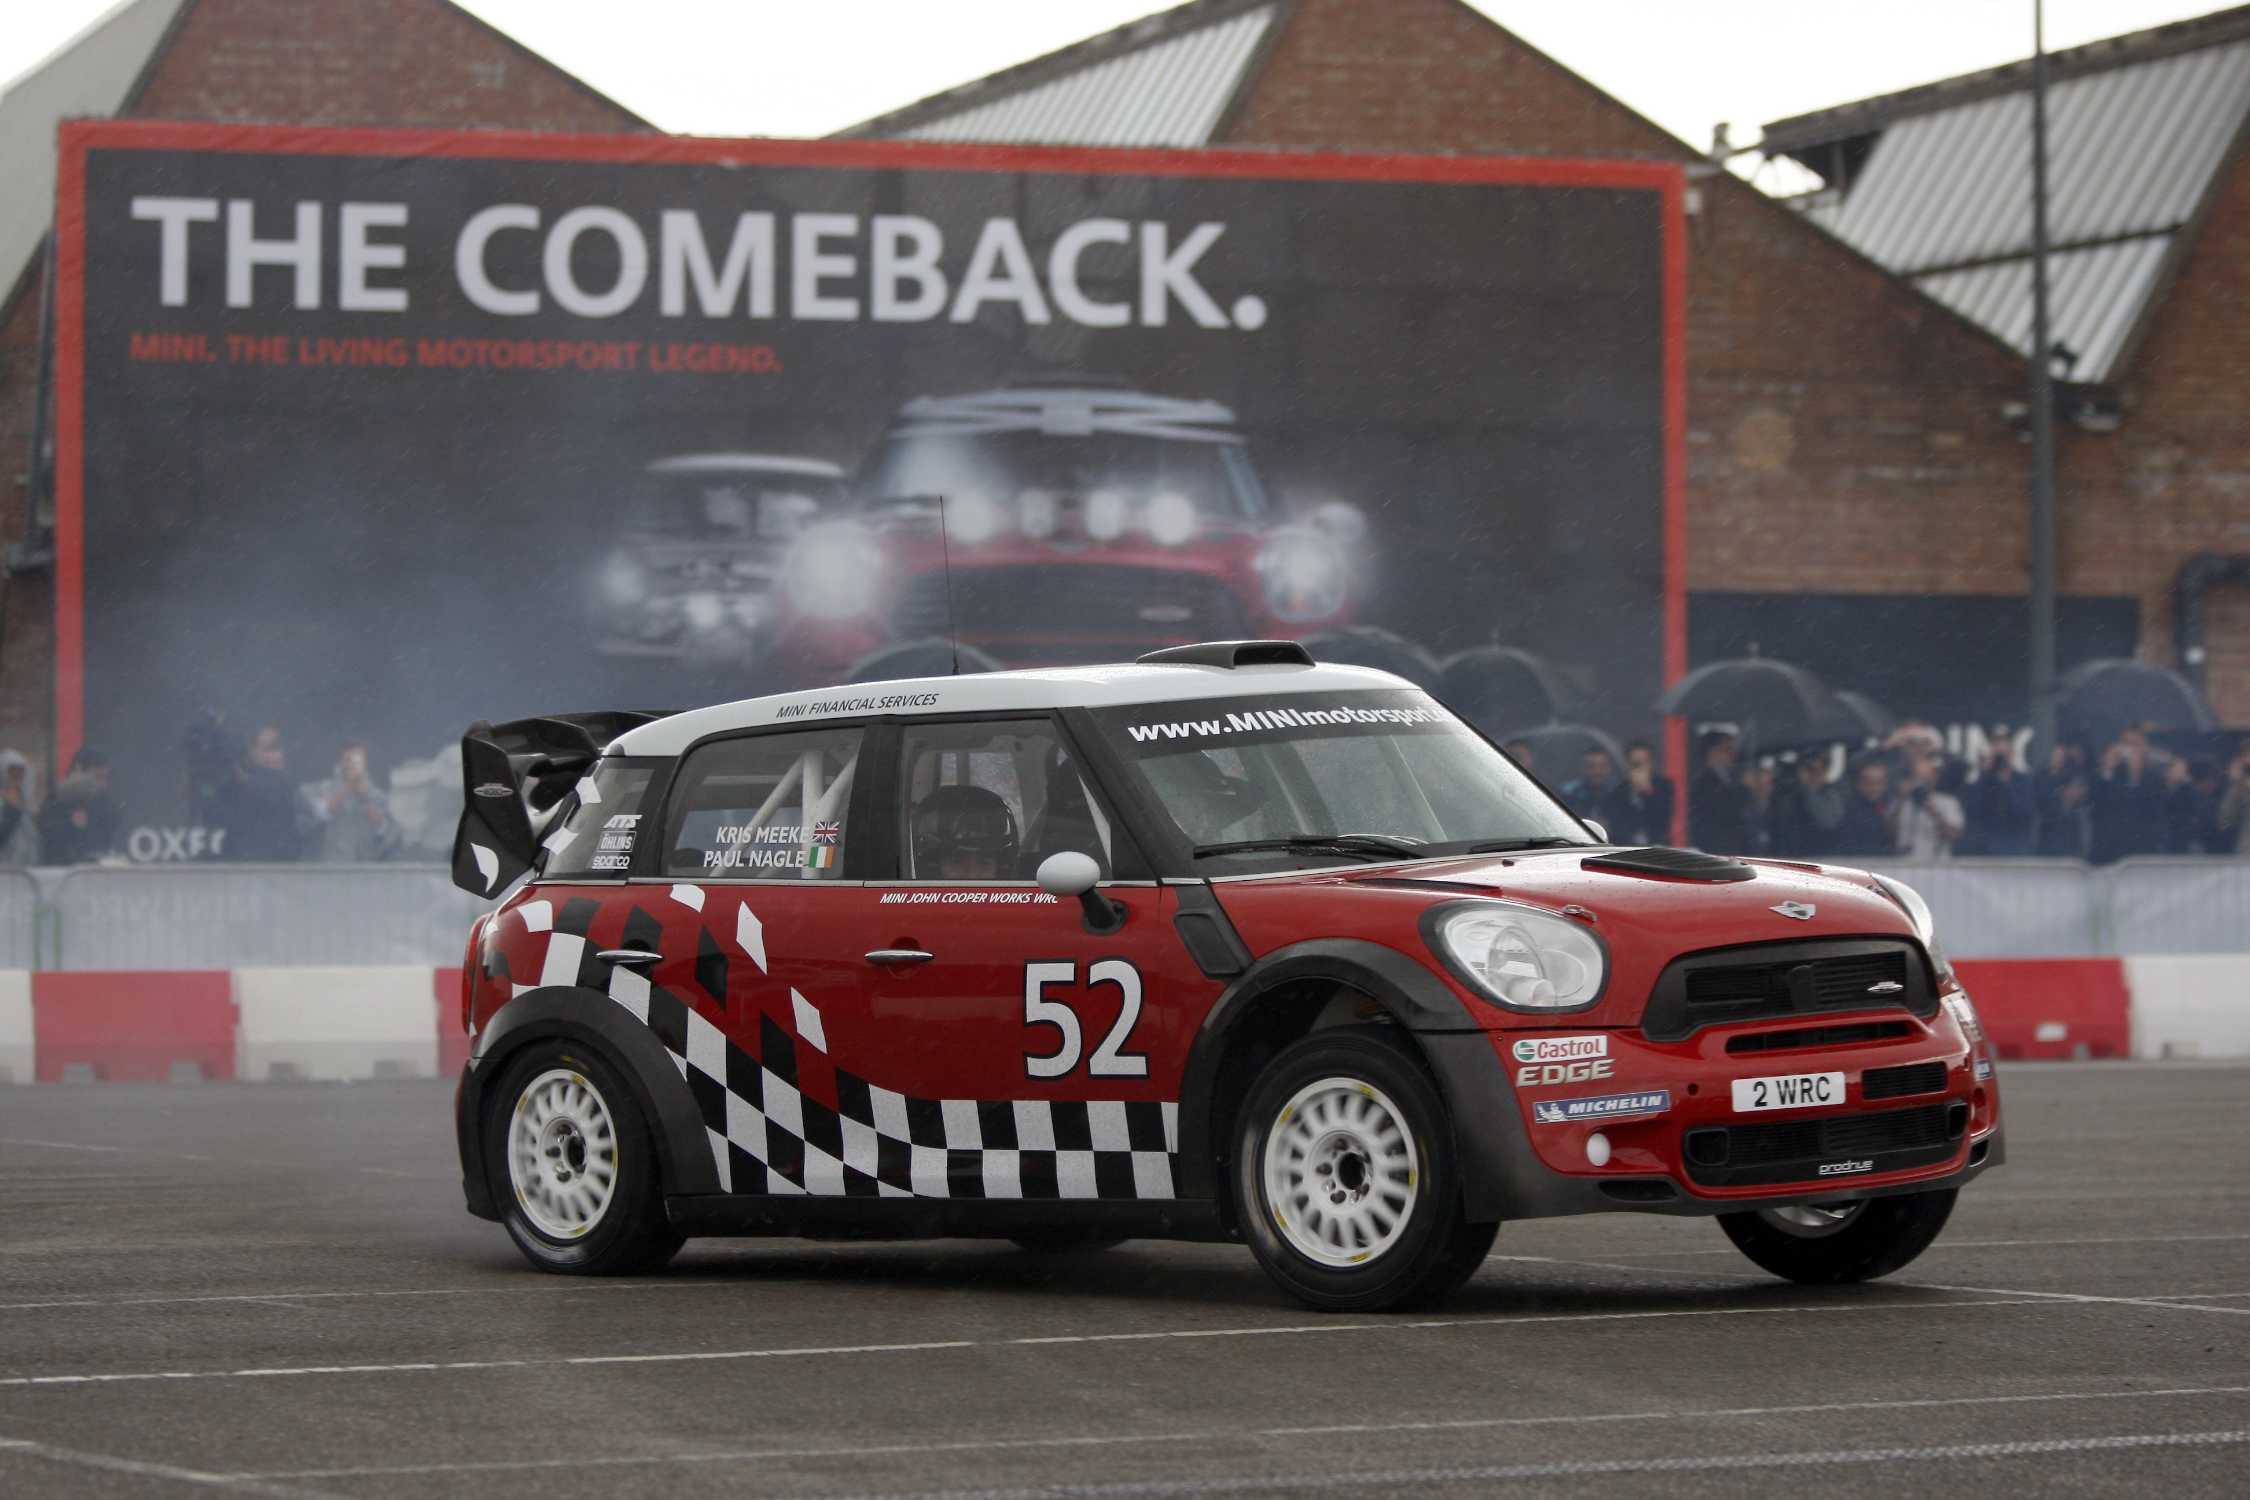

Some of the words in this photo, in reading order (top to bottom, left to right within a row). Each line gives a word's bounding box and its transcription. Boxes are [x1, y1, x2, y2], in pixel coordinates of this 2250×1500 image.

[131, 196, 409, 312] THE
[455, 204, 1268, 331] COMEBACK.
[130, 332, 217, 363] MINI.
[225, 334, 291, 366] THE
[300, 336, 409, 368] LIVING
[416, 337, 642, 371] MOTORSPORT
[651, 341, 784, 374] LEGEND.
[776, 704, 808, 718] MINI
[809, 698, 876, 714] FINANCIAL
[877, 693, 940, 709] SERVICES
[715, 826, 751, 844] KRIS
[755, 826, 810, 844] MEEKE
[703, 851, 745, 868] PAUL
[748, 851, 809, 868] NAGLE
[880, 892, 907, 904] MINI
[907, 892, 941, 904] JOHN
[941, 892, 988, 904] COOPER
[989, 892, 1034, 904] WORKS
[1025, 959, 1149, 1078] 52
[1537, 1038, 1602, 1059] Castrol
[1516, 1058, 1616, 1087] EDGE
[1753, 1081, 1768, 1107] 2
[1776, 1076, 1831, 1106] WRC
[1568, 1095, 1663, 1115] MICHELIN
